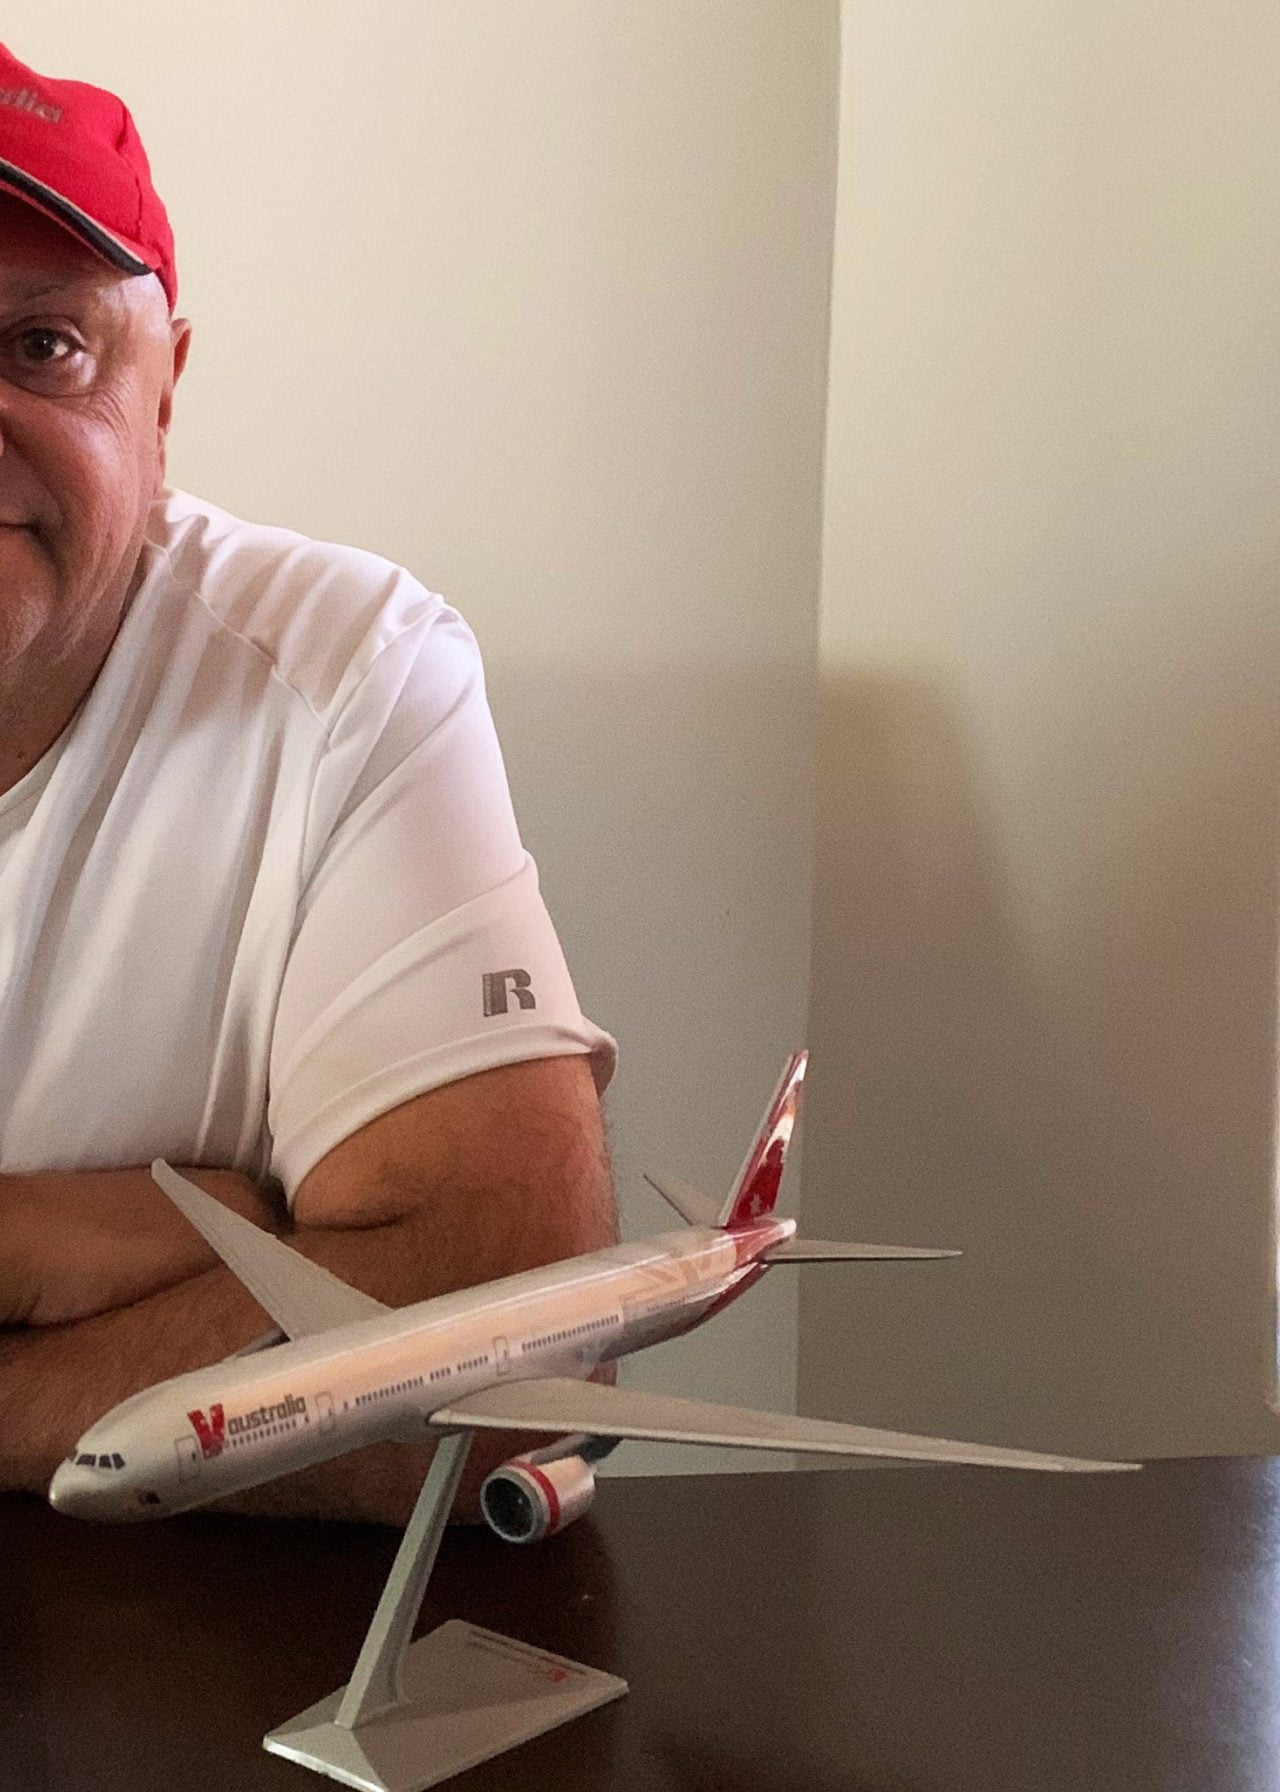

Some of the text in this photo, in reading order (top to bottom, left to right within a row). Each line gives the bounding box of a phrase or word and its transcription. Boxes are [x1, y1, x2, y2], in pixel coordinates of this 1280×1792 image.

[482, 968, 536, 1017] R
[187, 1393, 307, 1460] V australia
